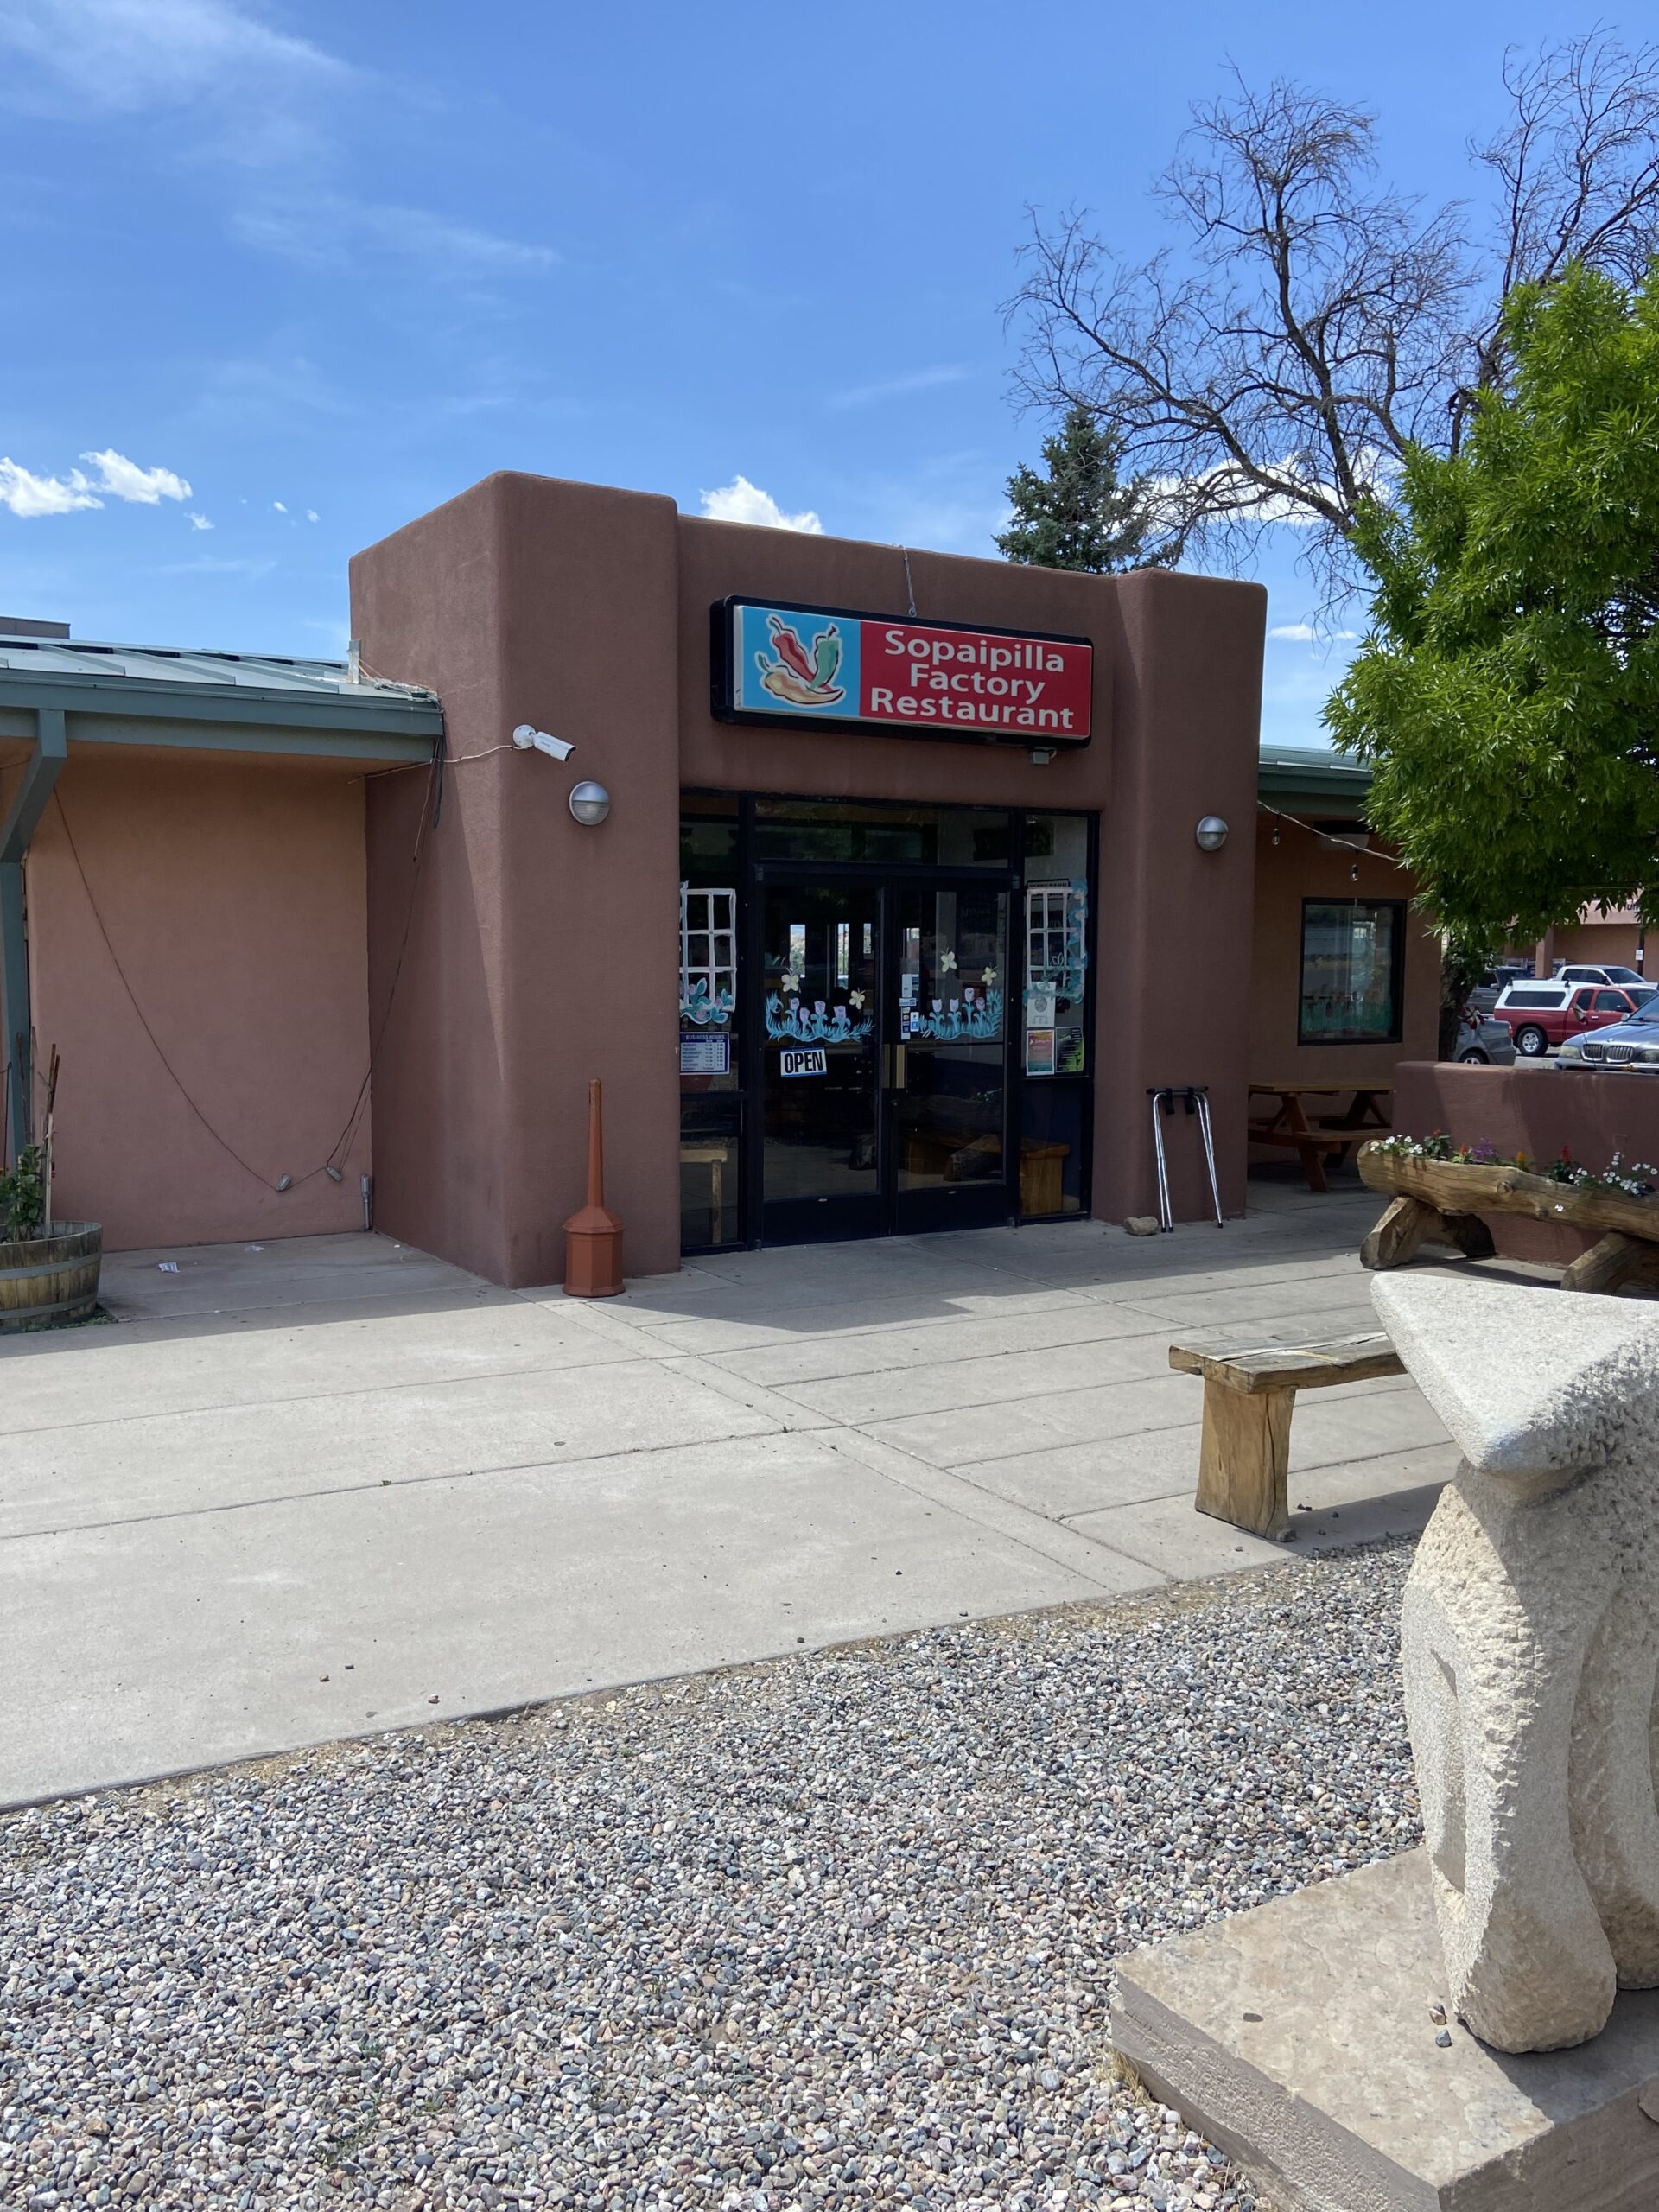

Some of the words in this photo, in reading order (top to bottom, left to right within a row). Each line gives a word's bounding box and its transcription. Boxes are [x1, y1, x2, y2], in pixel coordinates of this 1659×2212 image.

[885, 630, 1064, 672] Sopaipilla
[911, 663, 1046, 704] Factory
[871, 687, 1074, 728] Restaurant
[784, 1051, 823, 1073] OPEN
